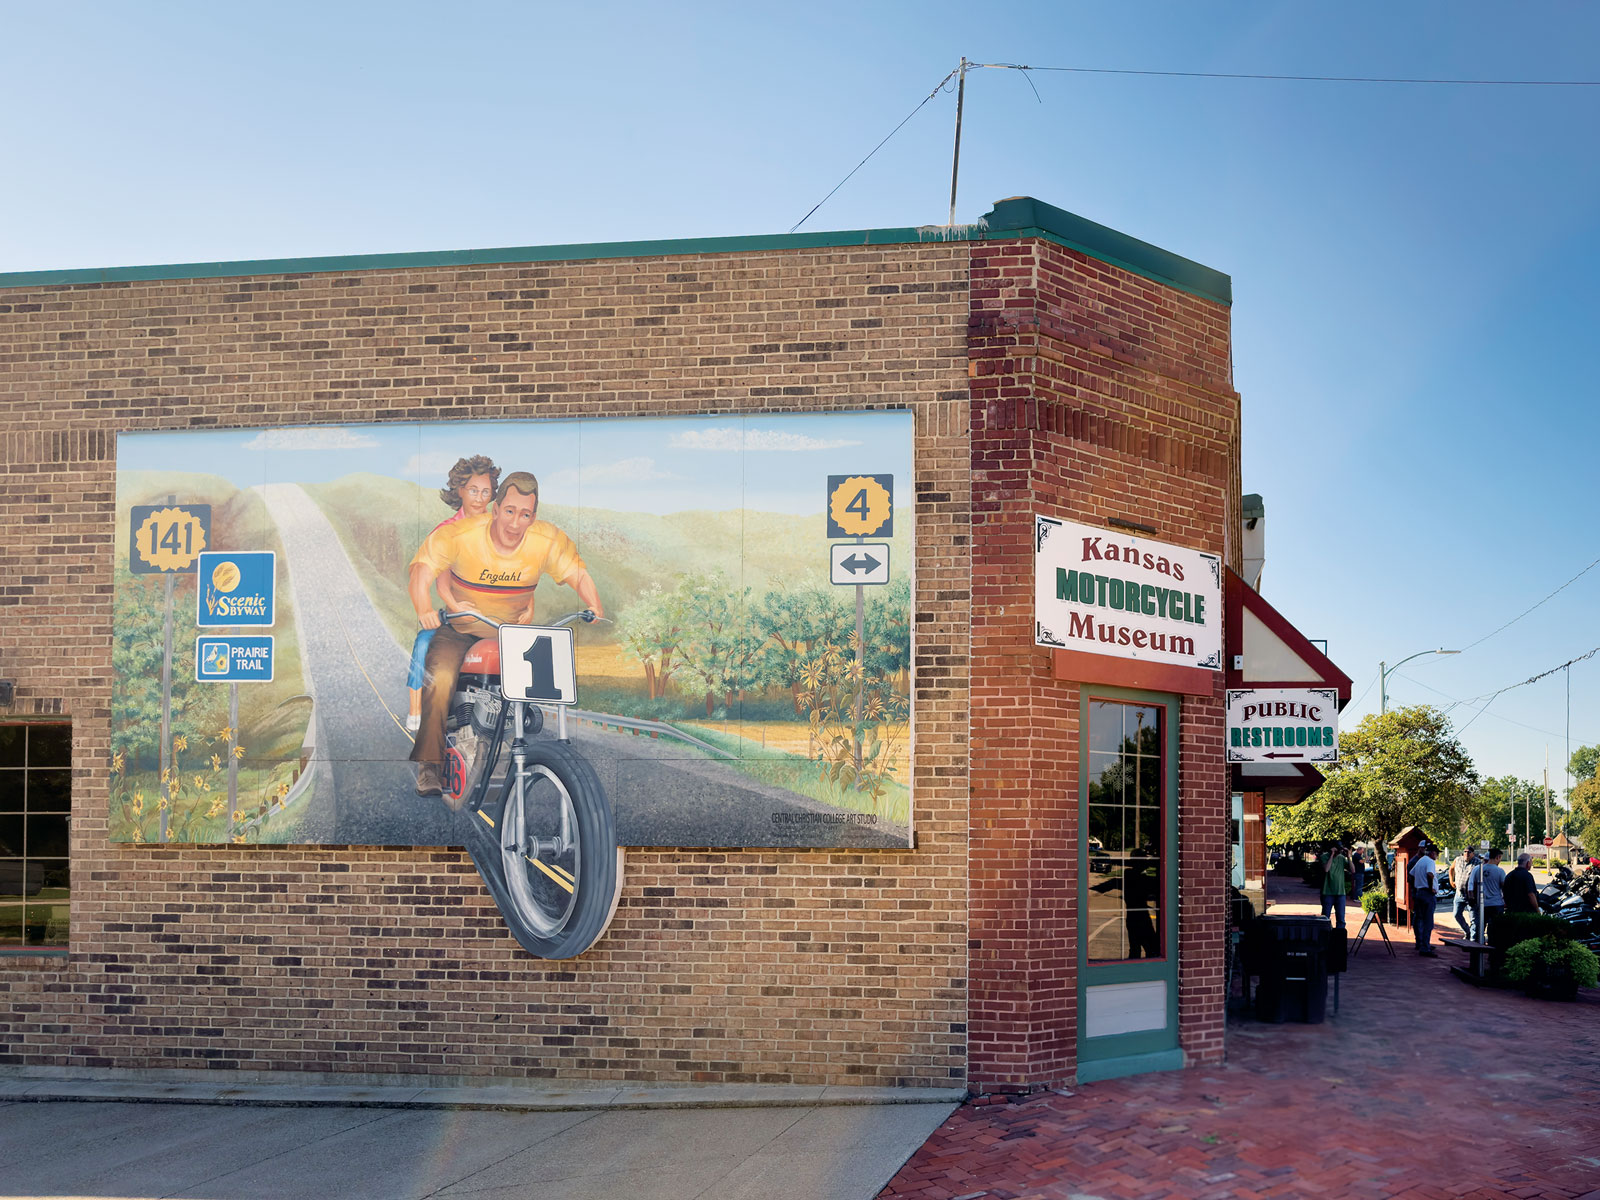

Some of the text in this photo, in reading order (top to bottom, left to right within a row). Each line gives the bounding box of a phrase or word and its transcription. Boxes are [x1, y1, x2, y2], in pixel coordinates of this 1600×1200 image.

[845, 489, 870, 521] 4
[149, 522, 193, 555] 141
[1081, 537, 1185, 581] Kansas
[479, 569, 521, 584] Engdahl
[216, 593, 265, 616] Scenic
[1056, 567, 1206, 626] MOTORCYCLE
[230, 606, 267, 616] BYWAY
[1068, 611, 1195, 655] Museum
[231, 647, 269, 658] PRAIRIE
[236, 659, 264, 670] TRAIL
[523, 636, 562, 700] 1
[1243, 702, 1321, 721] PUBLIC
[1231, 726, 1334, 747] RESTROOMS
[771, 813, 877, 824] CENTRAL CHRISTIAN COLLEGE ART STUDIO
